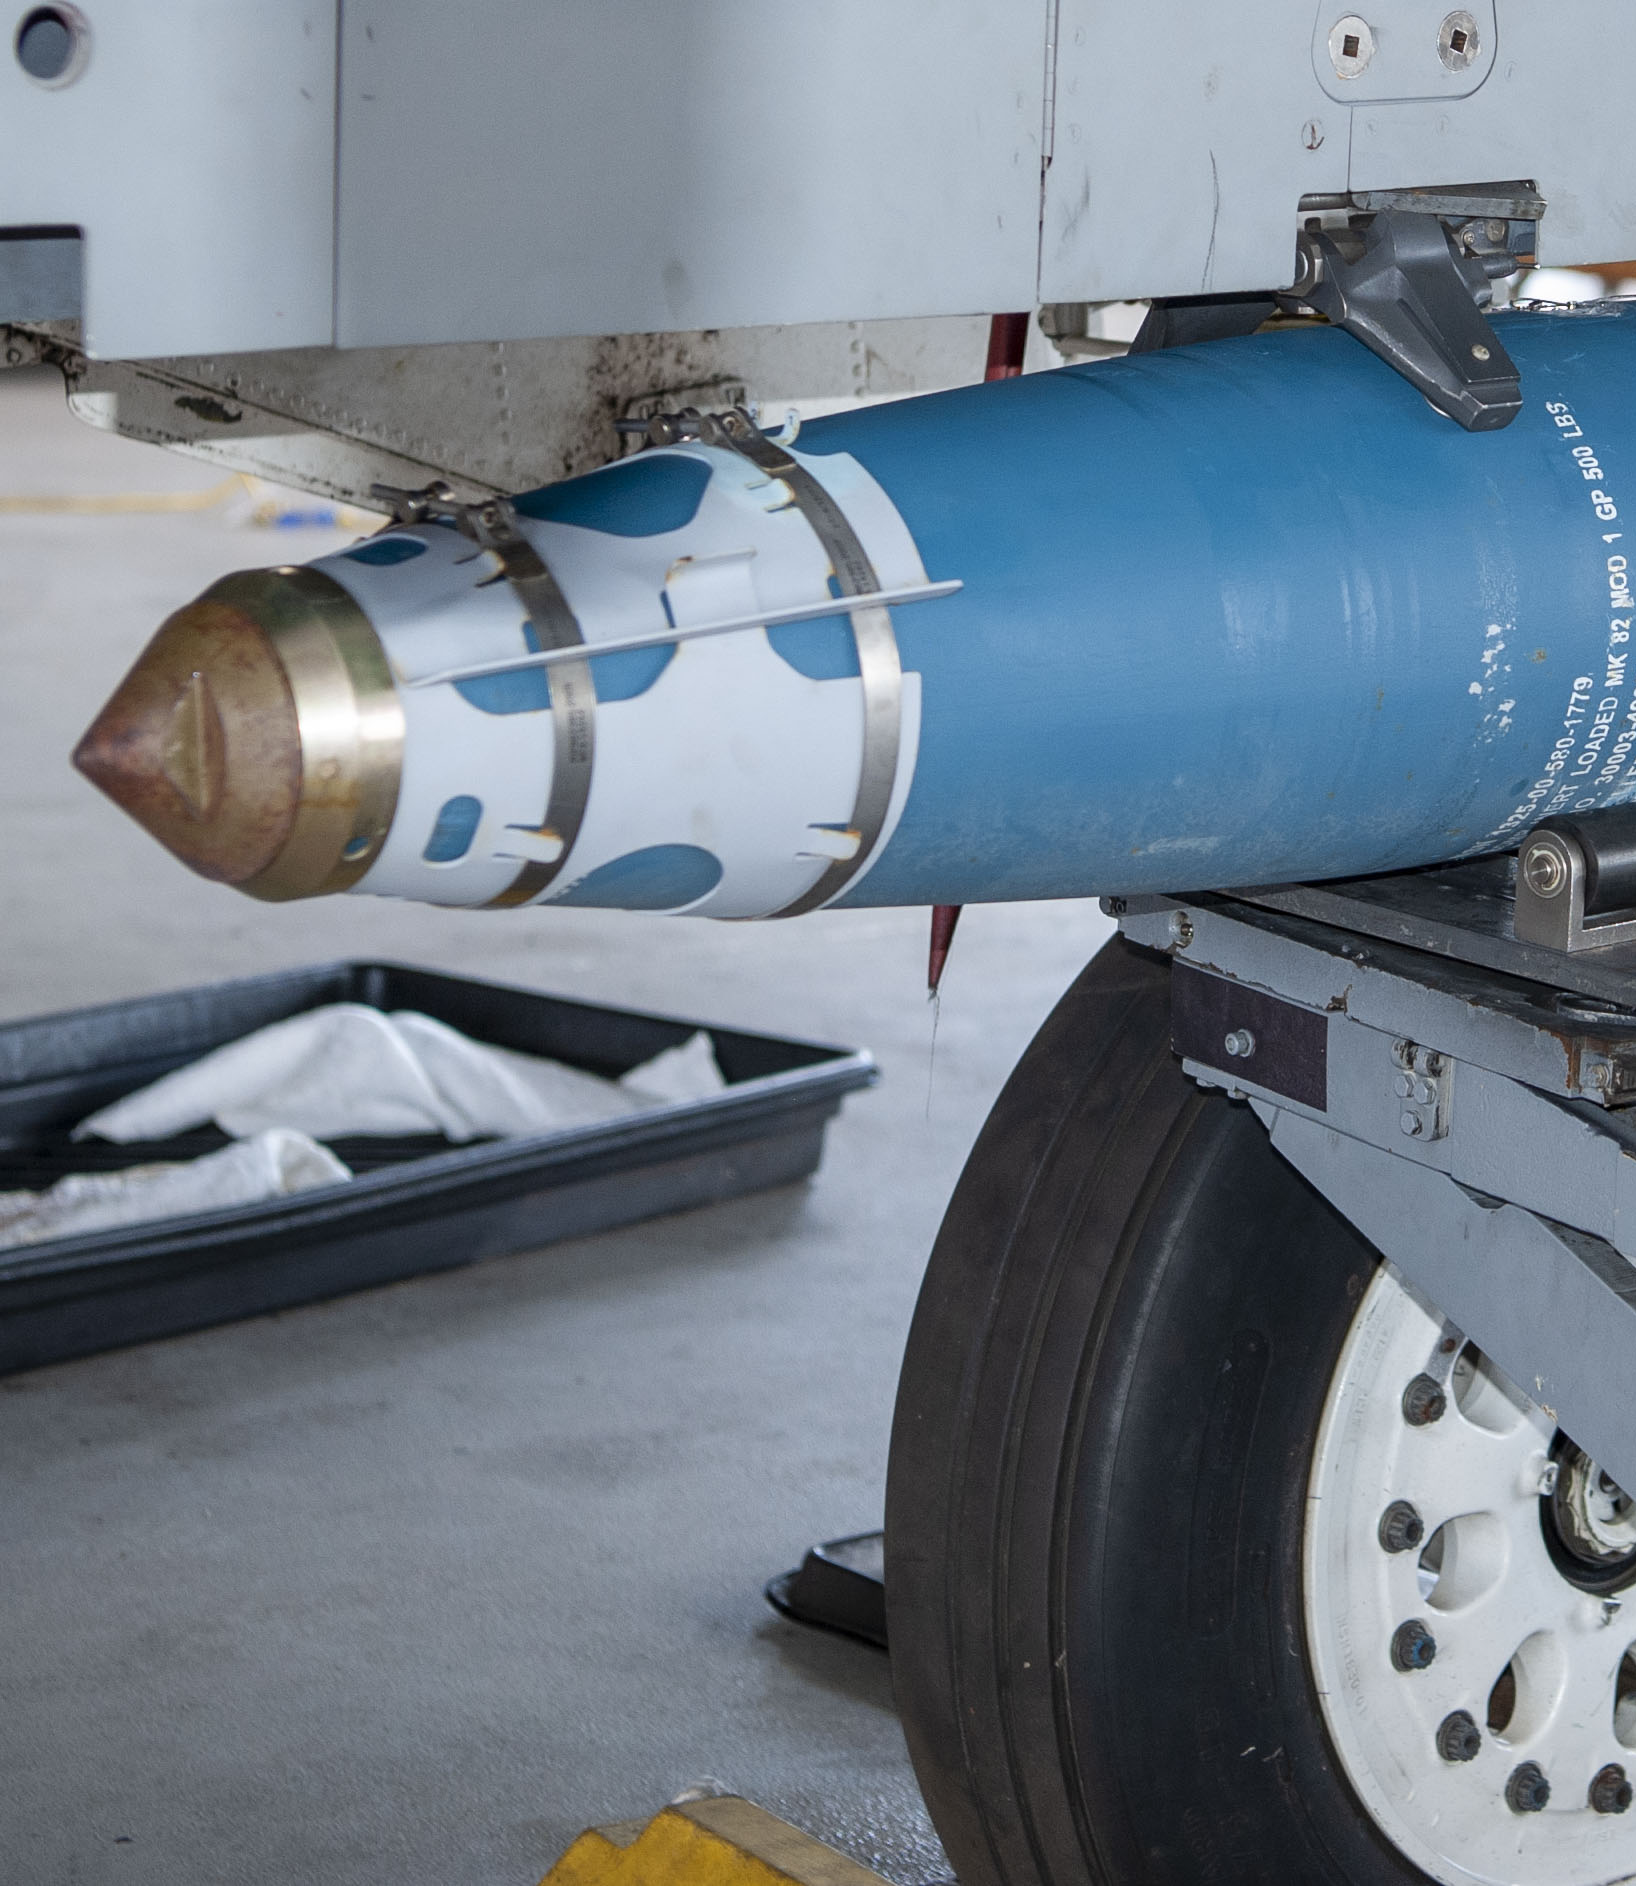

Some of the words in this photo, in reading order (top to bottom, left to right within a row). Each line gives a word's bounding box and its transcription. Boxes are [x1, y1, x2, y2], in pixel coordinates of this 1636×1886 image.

[1545, 400, 1583, 438] LBS
[1571, 446, 1604, 481] 500
[1591, 489, 1618, 521] GP
[1602, 533, 1623, 544] 1
[1607, 555, 1634, 608] MOD
[1610, 618, 1631, 644] 82
[1604, 653, 1628, 687] MK
[1570, 696, 1618, 777] LOADED
[1490, 676, 1594, 837] 1325-00-580-1779
